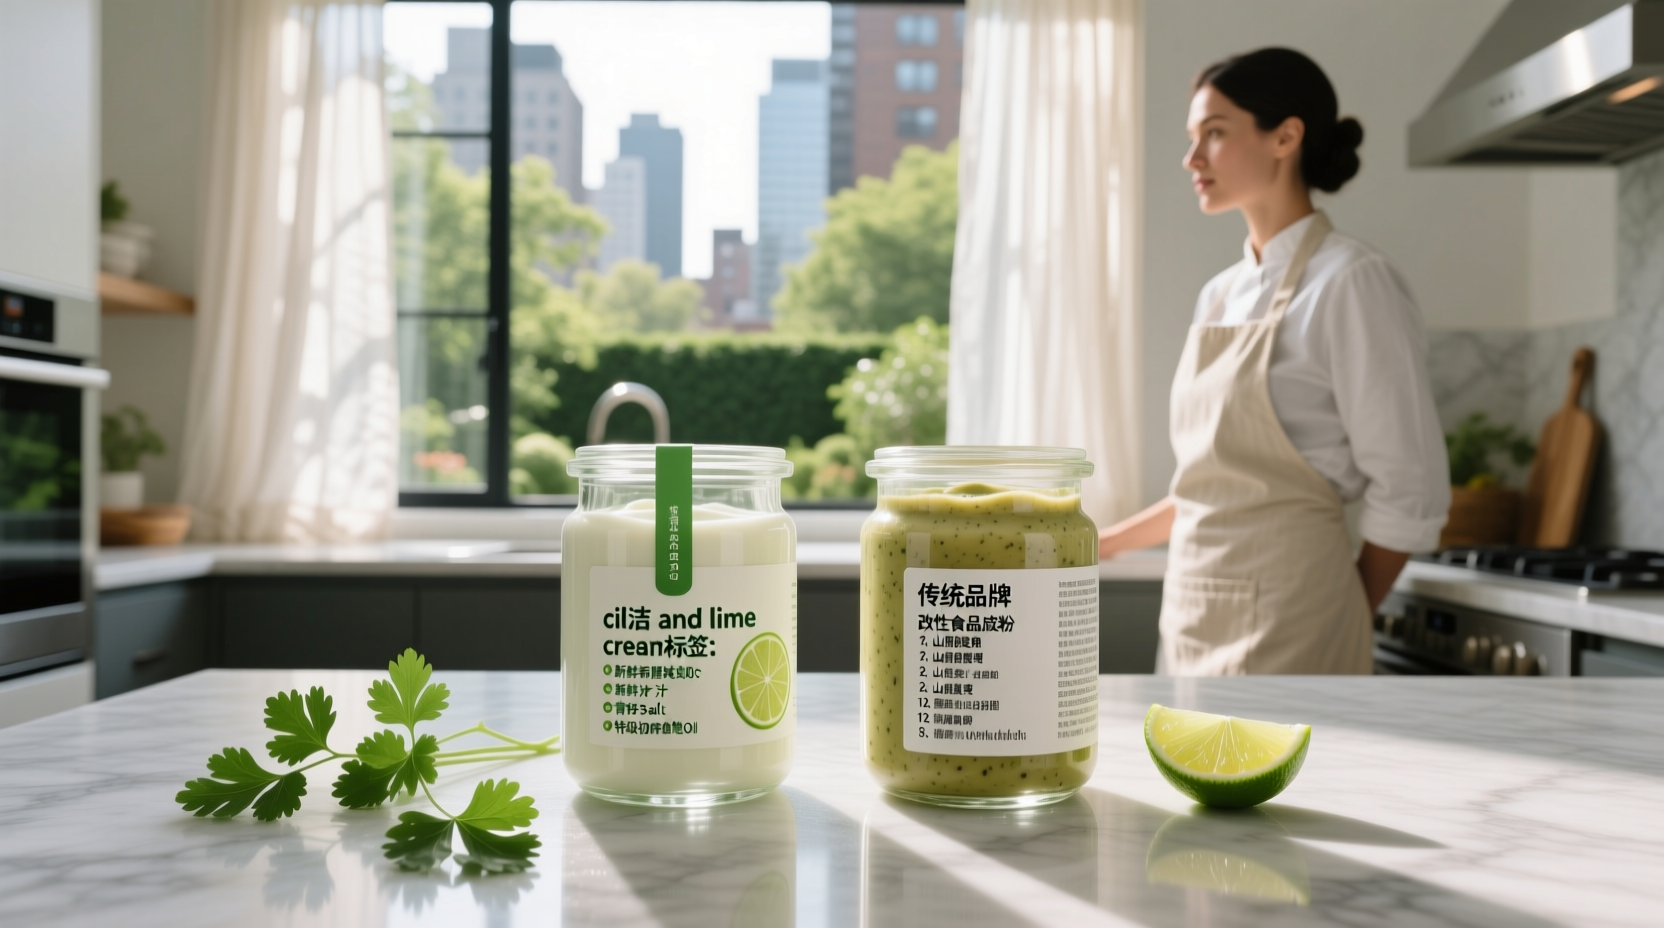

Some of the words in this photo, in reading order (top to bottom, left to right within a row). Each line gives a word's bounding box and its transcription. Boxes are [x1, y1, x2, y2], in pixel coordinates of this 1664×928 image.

[918, 583, 1012, 608] 传统品牌
[658, 607, 702, 630] and
[709, 606, 756, 630] lime
